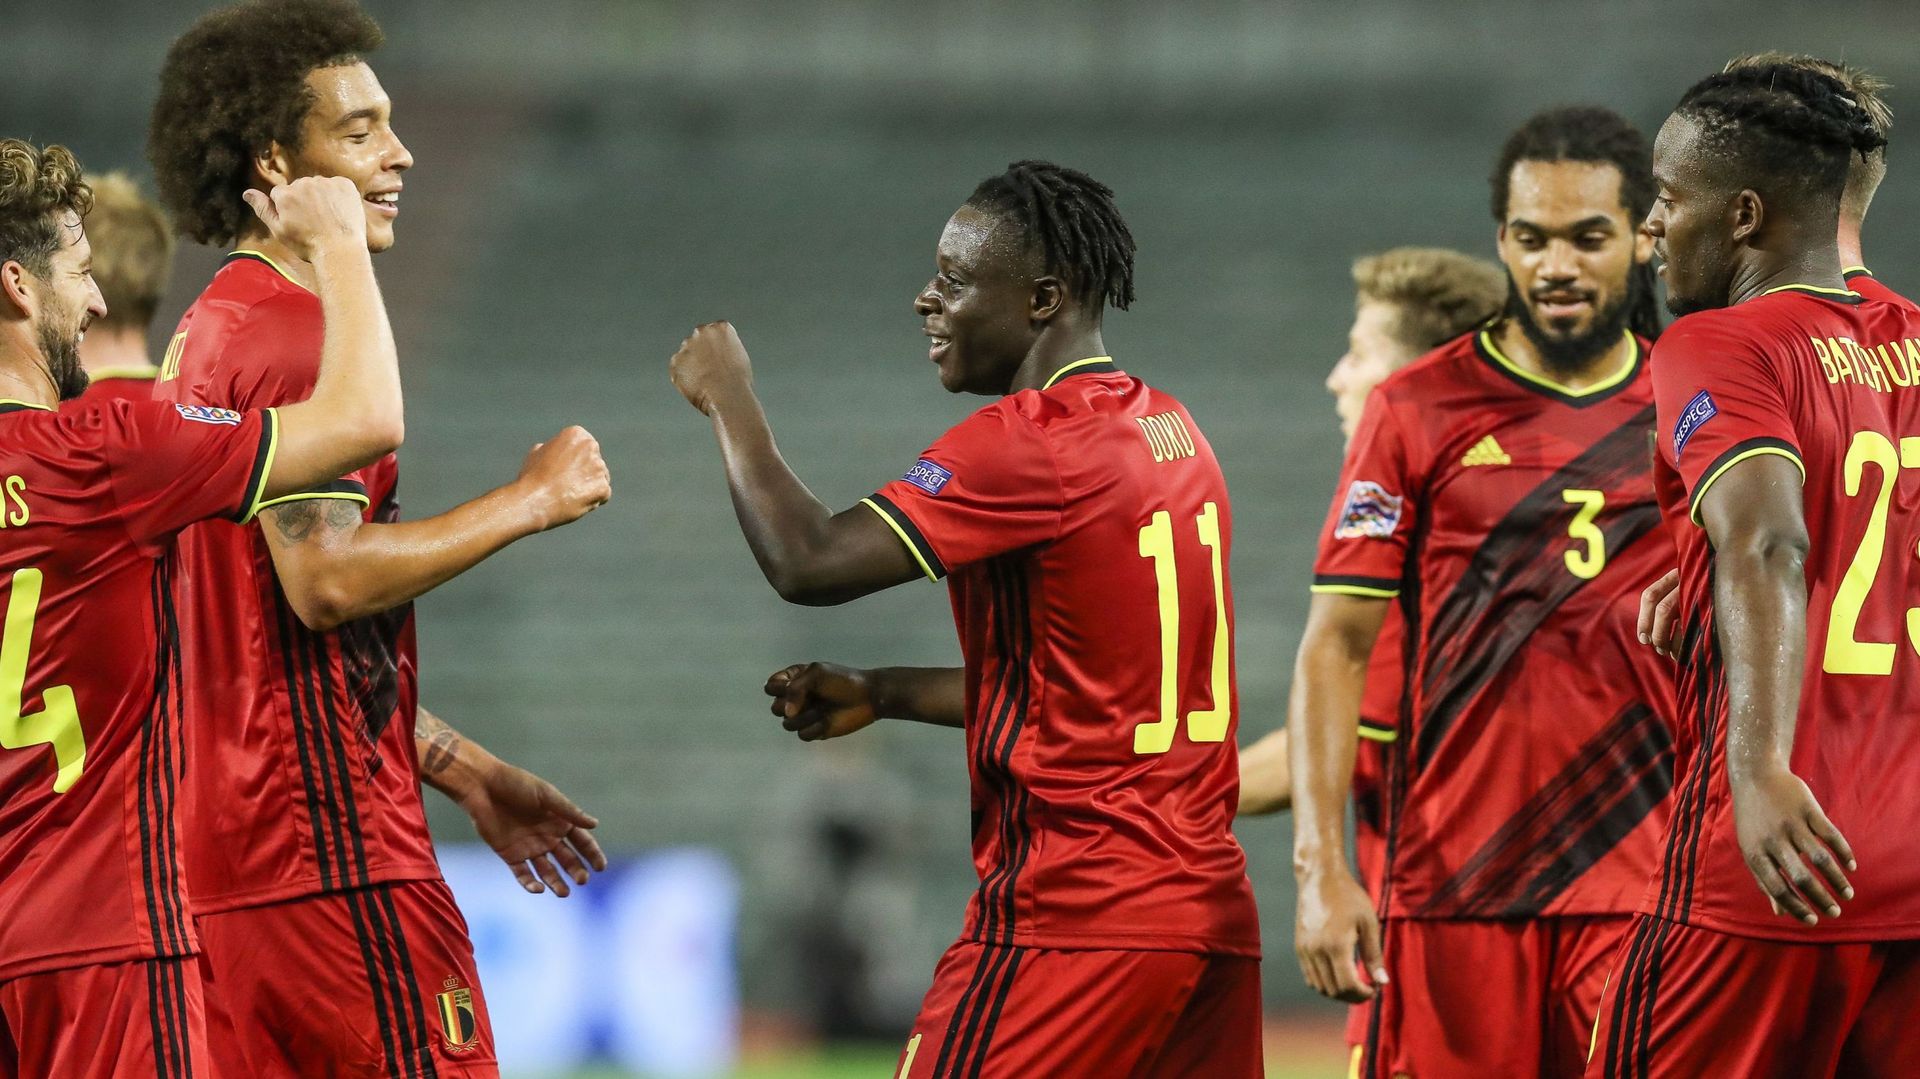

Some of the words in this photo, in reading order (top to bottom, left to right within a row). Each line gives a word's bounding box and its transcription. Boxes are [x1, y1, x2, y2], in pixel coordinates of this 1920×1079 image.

[1810, 336, 1920, 393] BATSHUA
[1134, 410, 1196, 463] DOKU
[1676, 396, 1712, 446] RESPECT
[906, 464, 948, 488] ESPECT
[1563, 489, 1606, 579] 3
[1133, 501, 1232, 755] 11
[0, 567, 87, 794] 4
